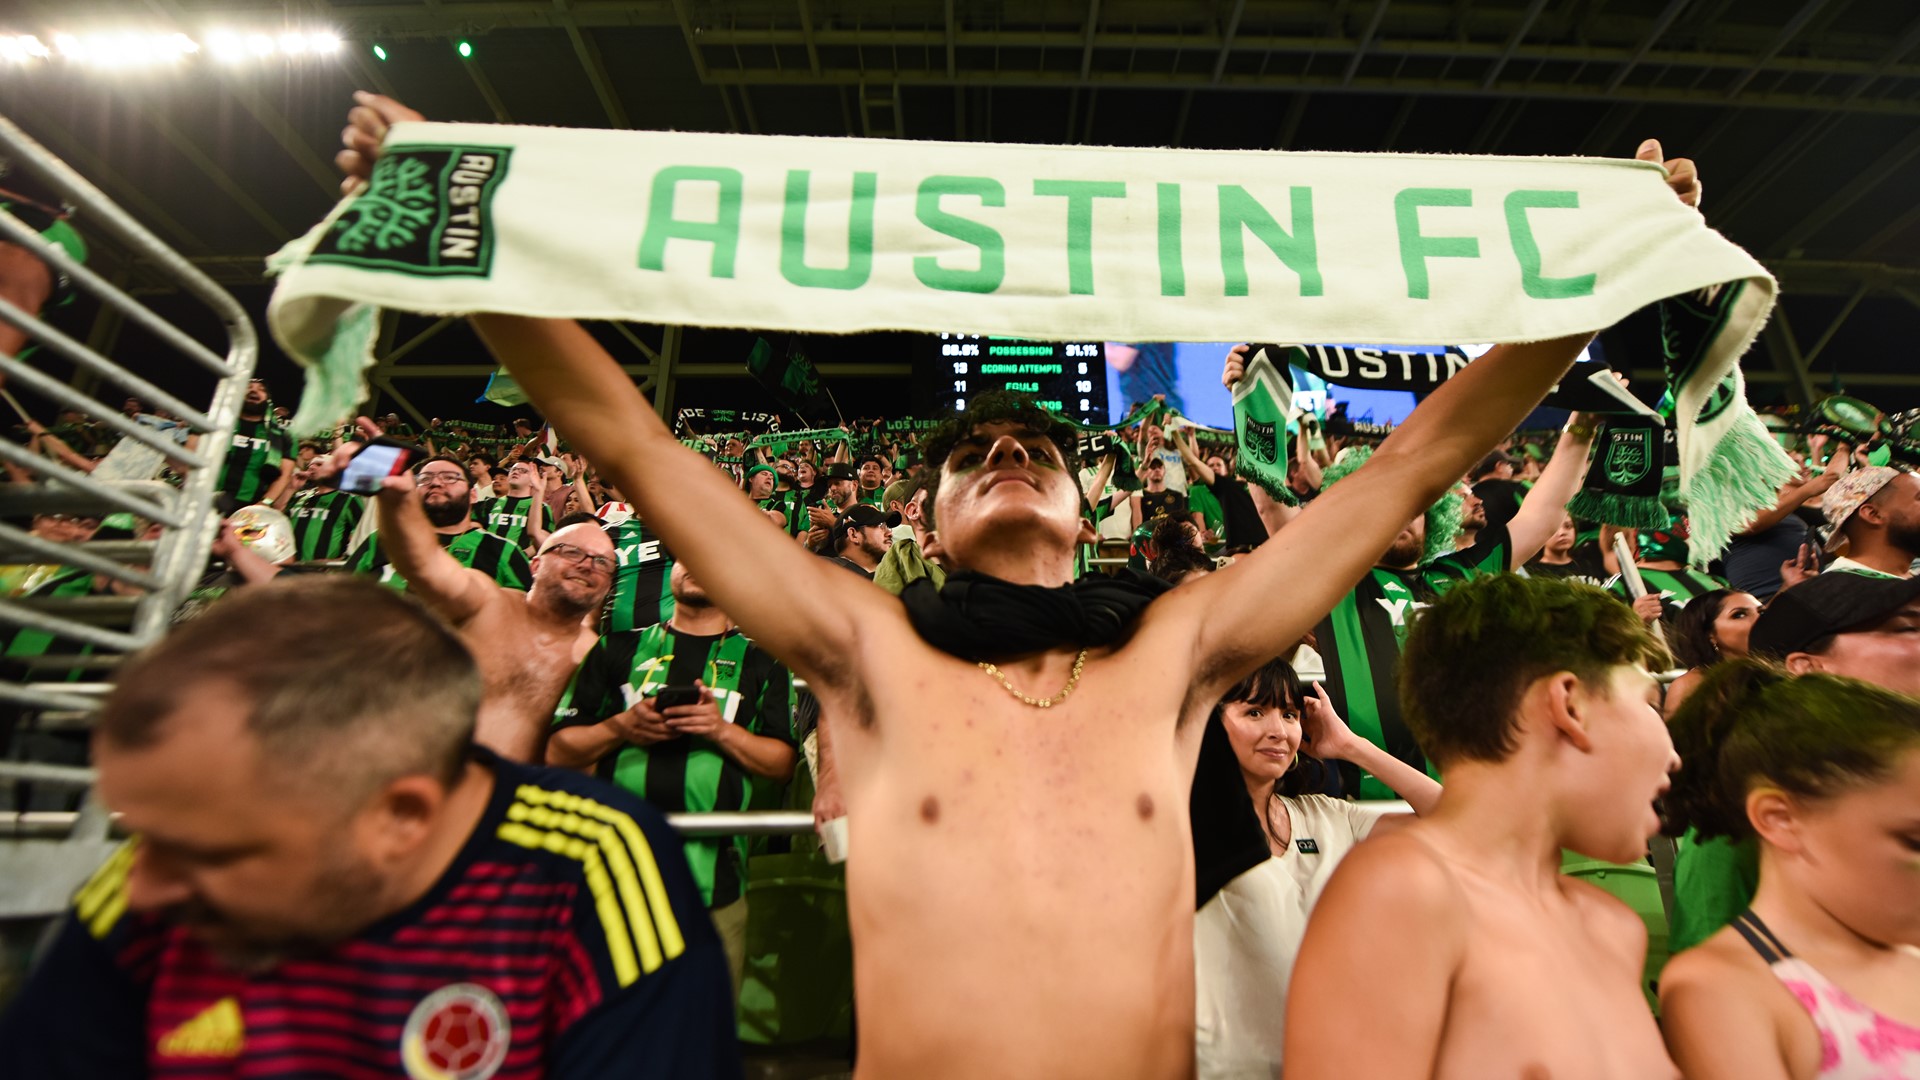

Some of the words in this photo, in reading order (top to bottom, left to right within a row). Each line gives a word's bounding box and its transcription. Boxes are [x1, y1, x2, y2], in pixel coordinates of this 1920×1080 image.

[439, 154, 495, 259] AUSTIN
[636, 165, 1324, 297] AUSTIN
[1394, 187, 1598, 301] FC
[989, 346, 1054, 356] POSSESSION
[981, 364, 1018, 374] SCORING
[1018, 364, 1063, 374] ATTEMPTS
[954, 380, 967, 393] 11
[1005, 382, 1039, 393] FOULS
[1075, 380, 1092, 393] 10
[886, 420, 911, 430] LOS
[232, 434, 271, 453] ETI
[1613, 433, 1644, 442] STIN
[1077, 435, 1105, 456] FC
[289, 507, 330, 521] YETI
[488, 512, 528, 528] YETI
[613, 540, 661, 567] YE
